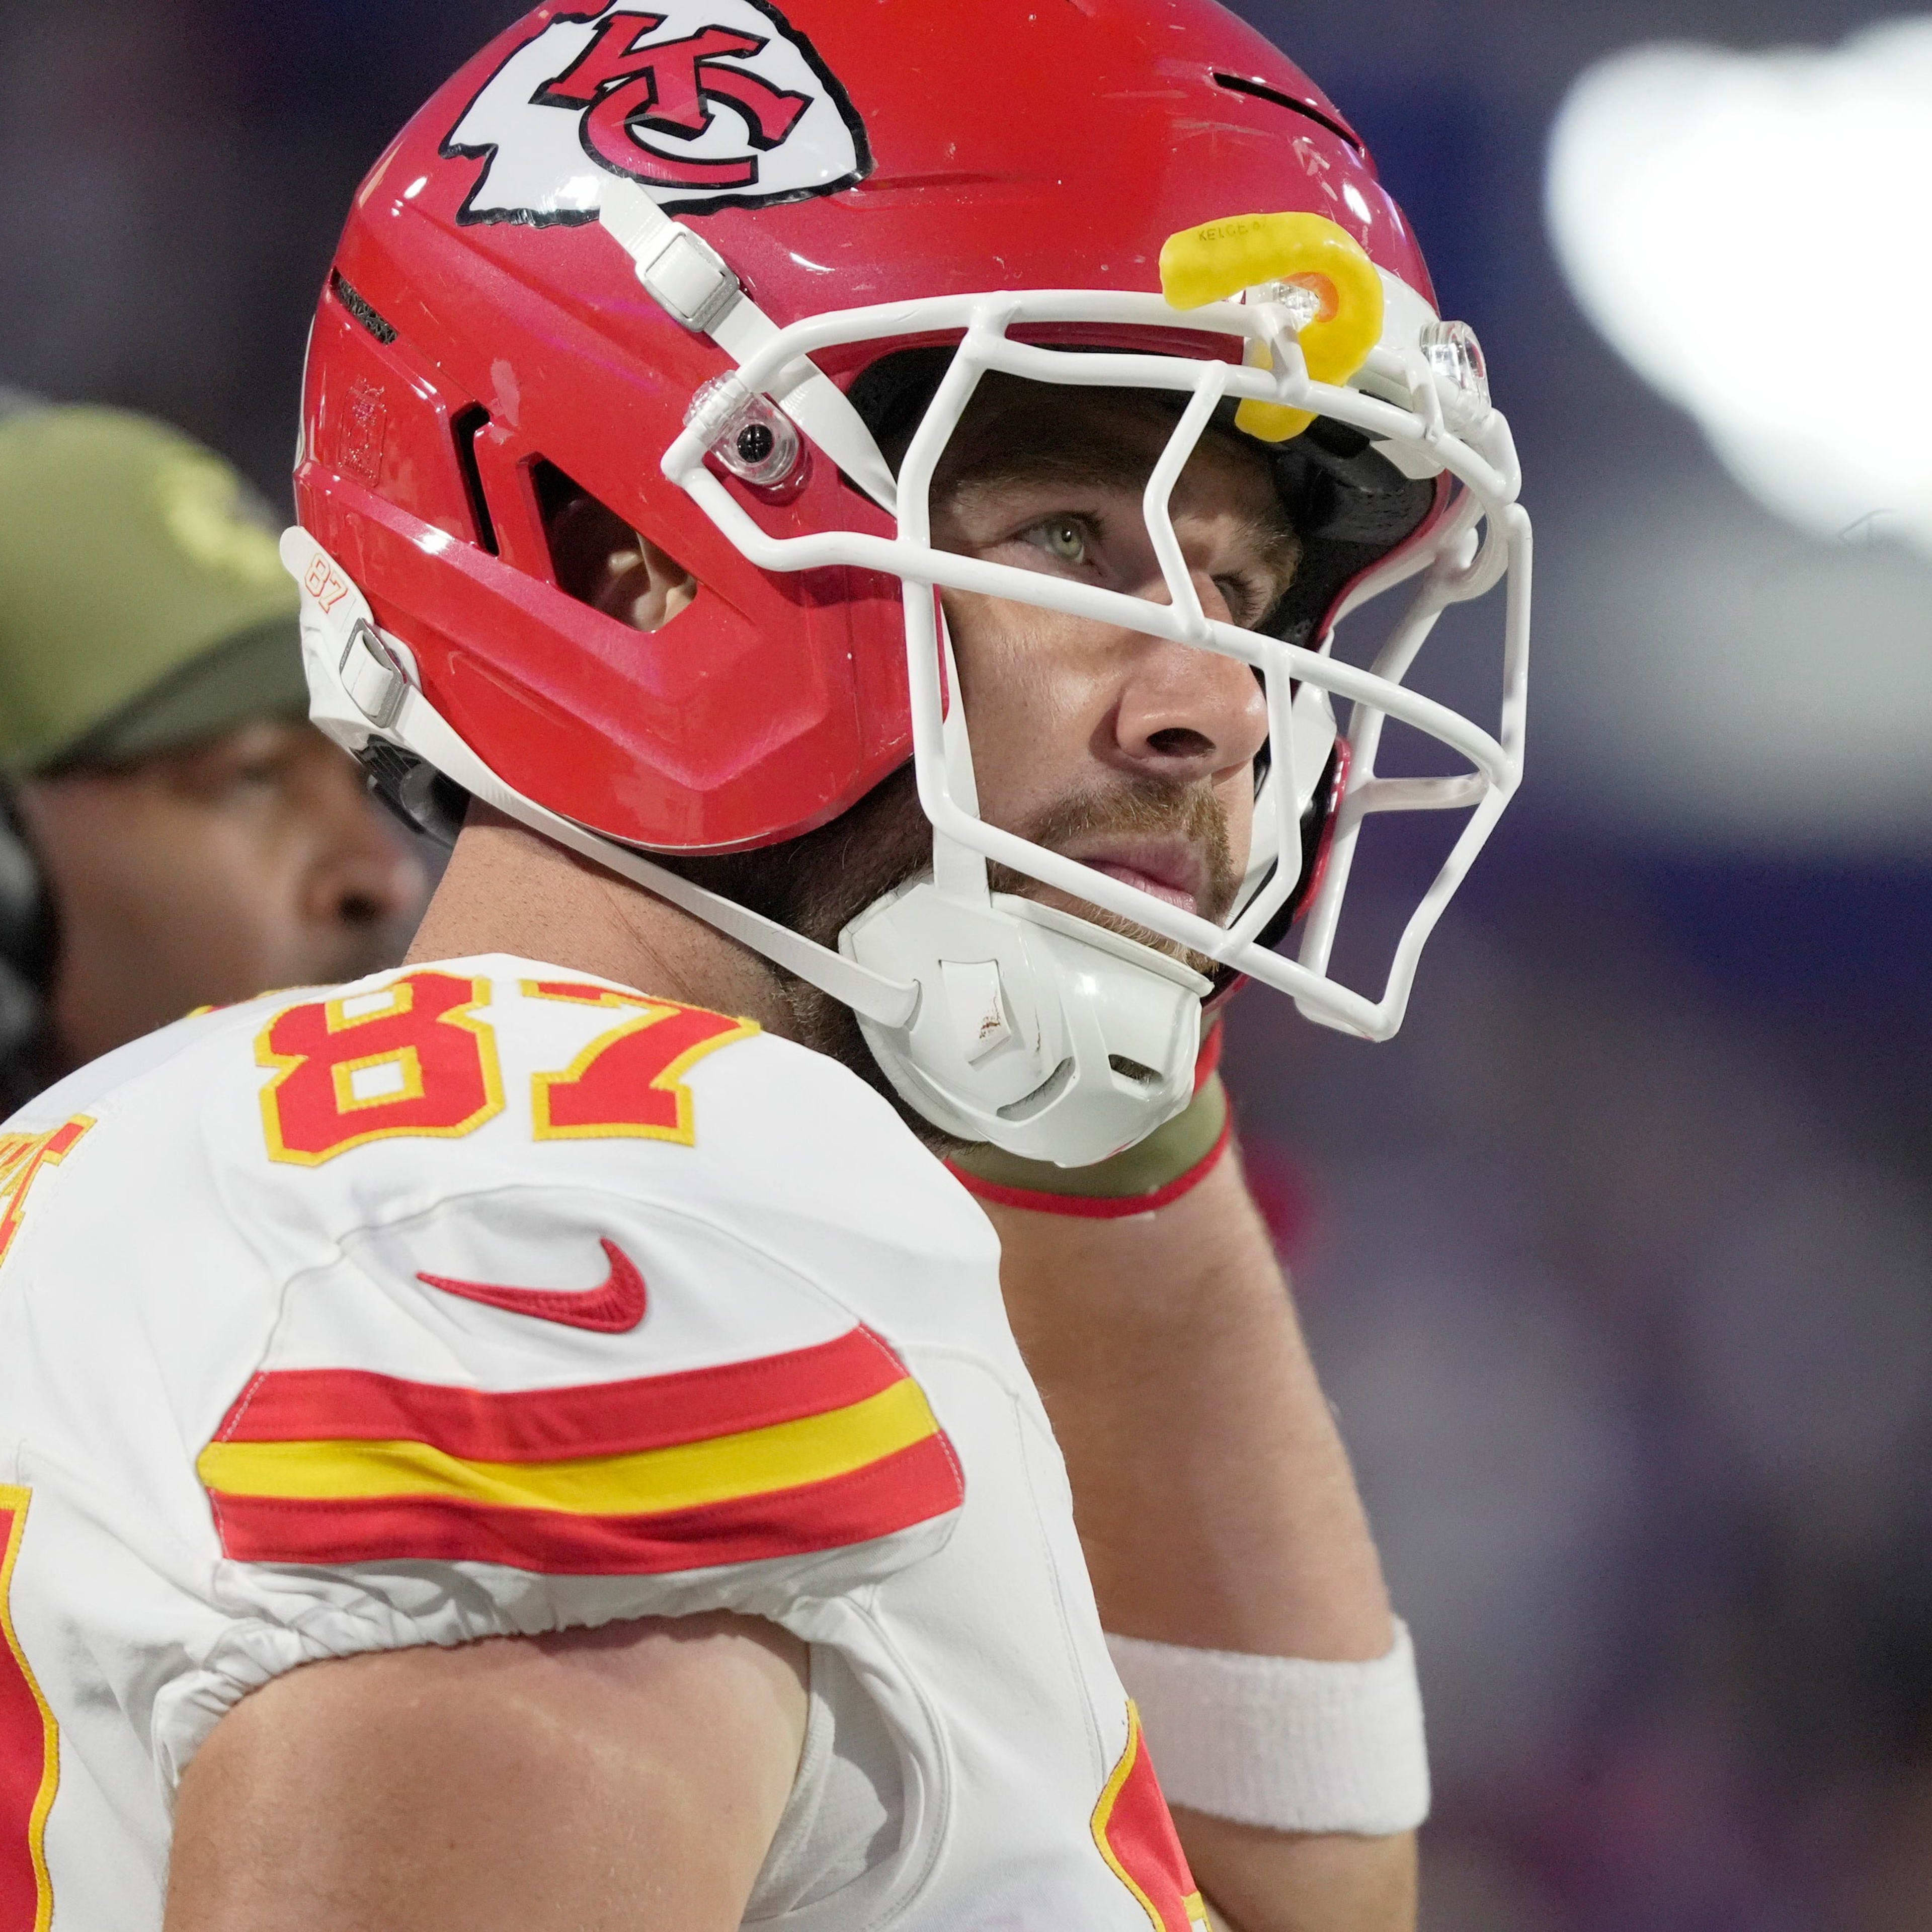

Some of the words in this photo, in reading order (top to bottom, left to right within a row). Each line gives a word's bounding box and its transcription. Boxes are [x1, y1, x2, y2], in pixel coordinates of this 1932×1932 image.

[528, 10, 815, 189] KC
[304, 552, 348, 614] 87
[254, 969, 761, 1167] 87
